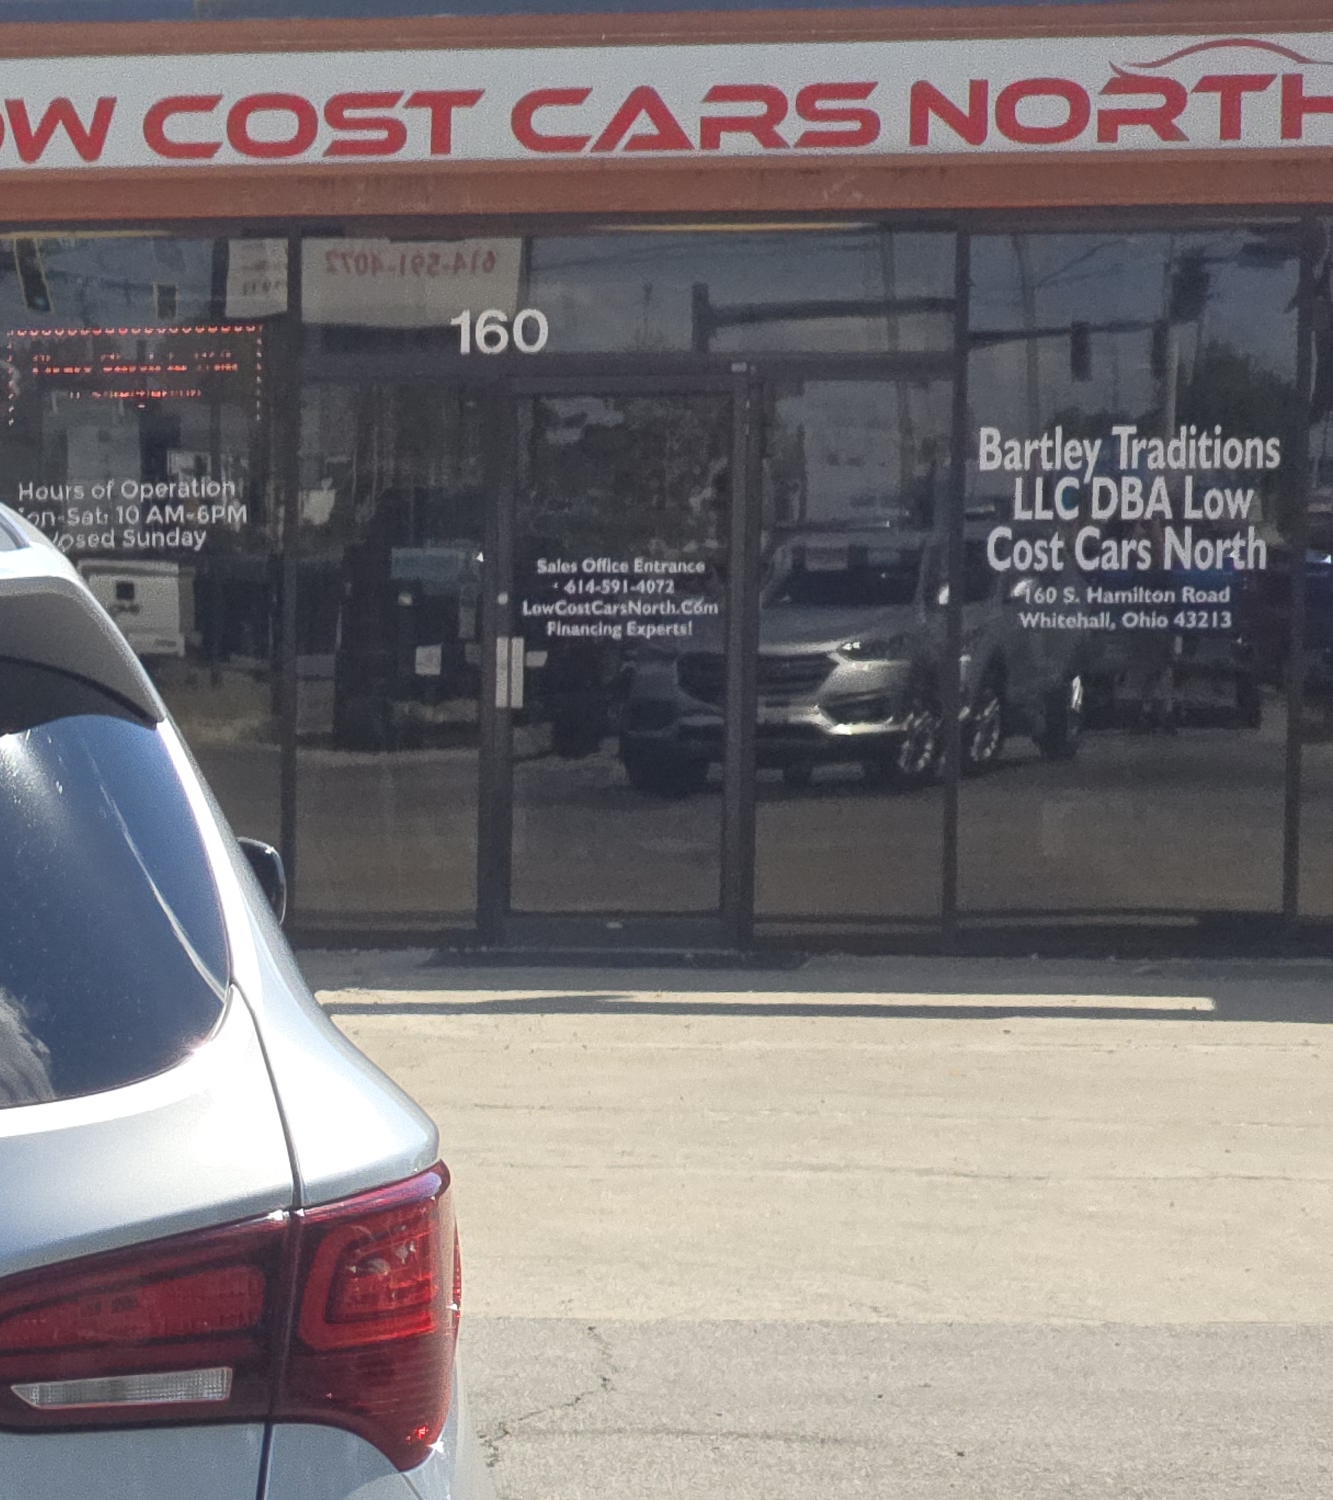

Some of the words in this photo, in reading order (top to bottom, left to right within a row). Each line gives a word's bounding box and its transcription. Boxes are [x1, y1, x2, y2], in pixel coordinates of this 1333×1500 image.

[142, 89, 486, 160] COST
[510, 80, 882, 154] CARS
[909, 73, 1333, 148] NORTH
[451, 309, 549, 354] 160
[979, 425, 1102, 483] Bartley
[1112, 424, 1281, 470] Traditions
[18, 481, 84, 501] Hours
[91, 478, 115, 499] of
[121, 479, 235, 502] Operation
[1014, 476, 1080, 521] LLC
[1091, 476, 1173, 521] DBA
[1183, 475, 1254, 520] Low
[116, 505, 140, 524] 10
[145, 505, 247, 524] AM-6PM
[122, 527, 206, 551] Sunday
[987, 526, 1064, 571] Cost
[1074, 526, 1152, 571] Cars
[1163, 525, 1267, 571] North
[537, 558, 577, 574] Sales
[582, 558, 628, 574] Office
[634, 558, 706, 574] Entrance
[563, 579, 675, 594] 614-591-4072
[1024, 587, 1057, 604] 160
[1063, 586, 1080, 605] S.
[1087, 586, 1175, 604] Hamilton
[1182, 586, 1231, 604] Road
[547, 621, 622, 640] Financing
[627, 621, 693, 639] Experts!
[1019, 611, 1116, 630] Whitehall,
[1121, 611, 1169, 629] Ohio
[1173, 610, 1232, 629] 43213
